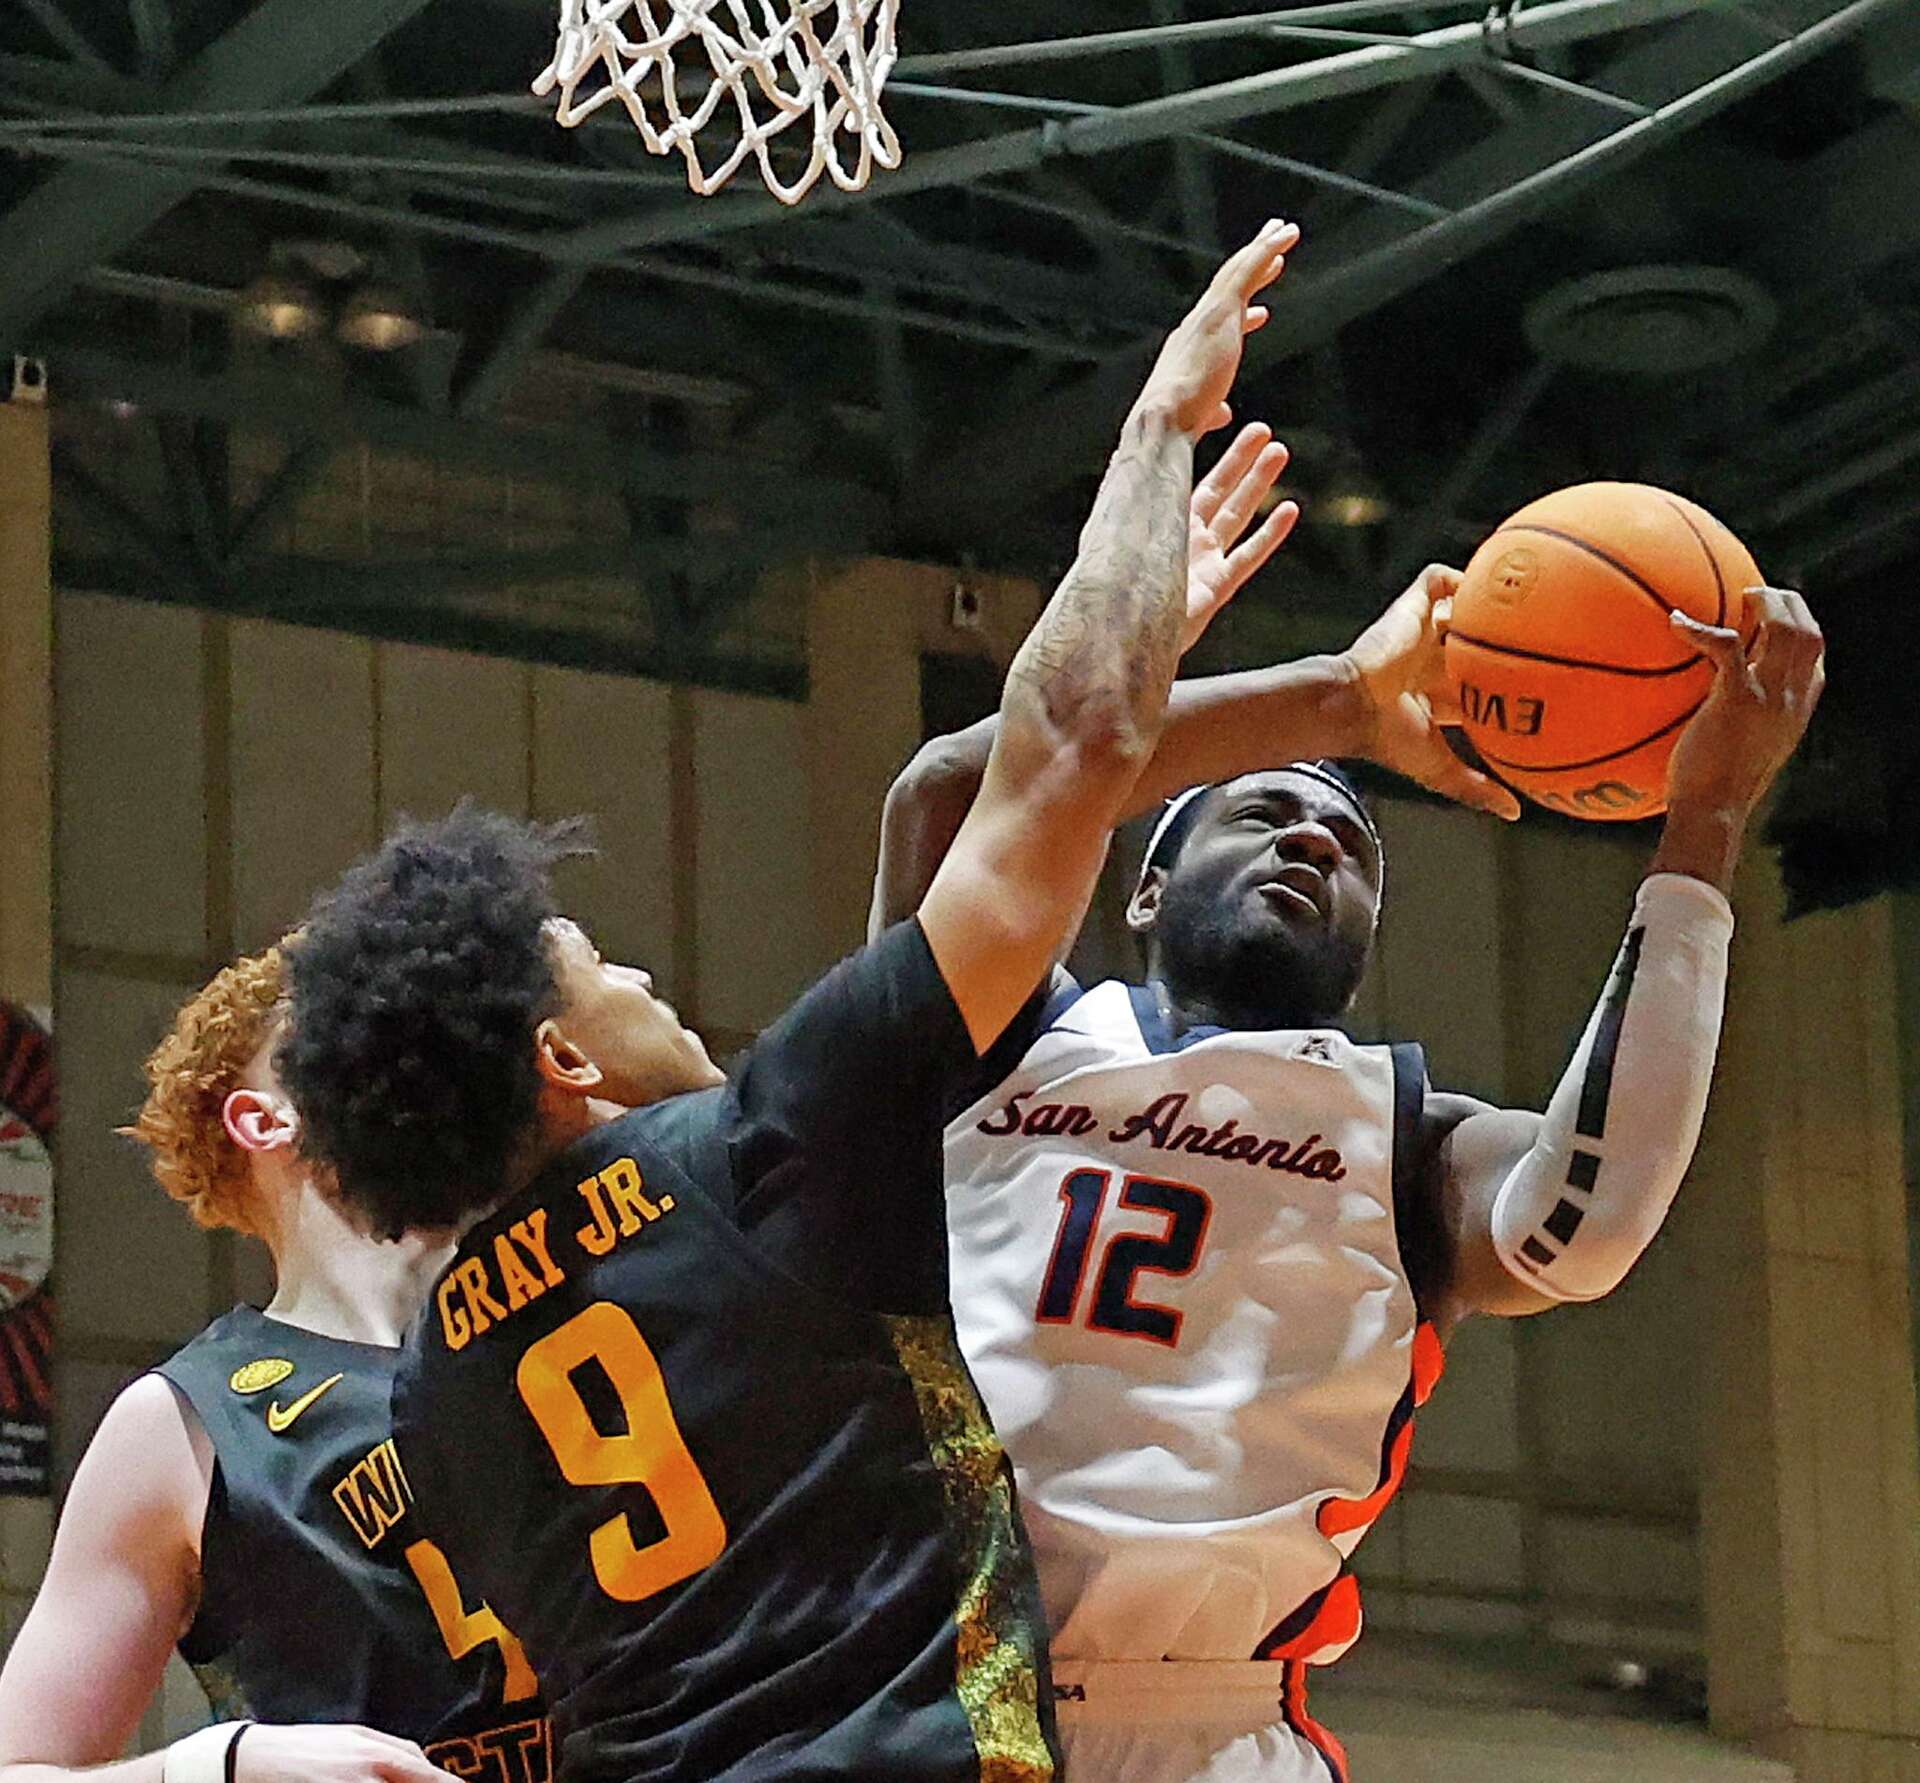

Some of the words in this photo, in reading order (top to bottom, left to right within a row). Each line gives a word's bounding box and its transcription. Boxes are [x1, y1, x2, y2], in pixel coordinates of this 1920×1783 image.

[977, 1091, 1098, 1137] San
[1109, 1093, 1347, 1182] Antonio
[437, 1208, 566, 1351] GRAY
[576, 1157, 675, 1256] JR.
[1036, 1167, 1213, 1348] 12
[332, 1438, 414, 1549] W
[517, 1301, 727, 1602] 9
